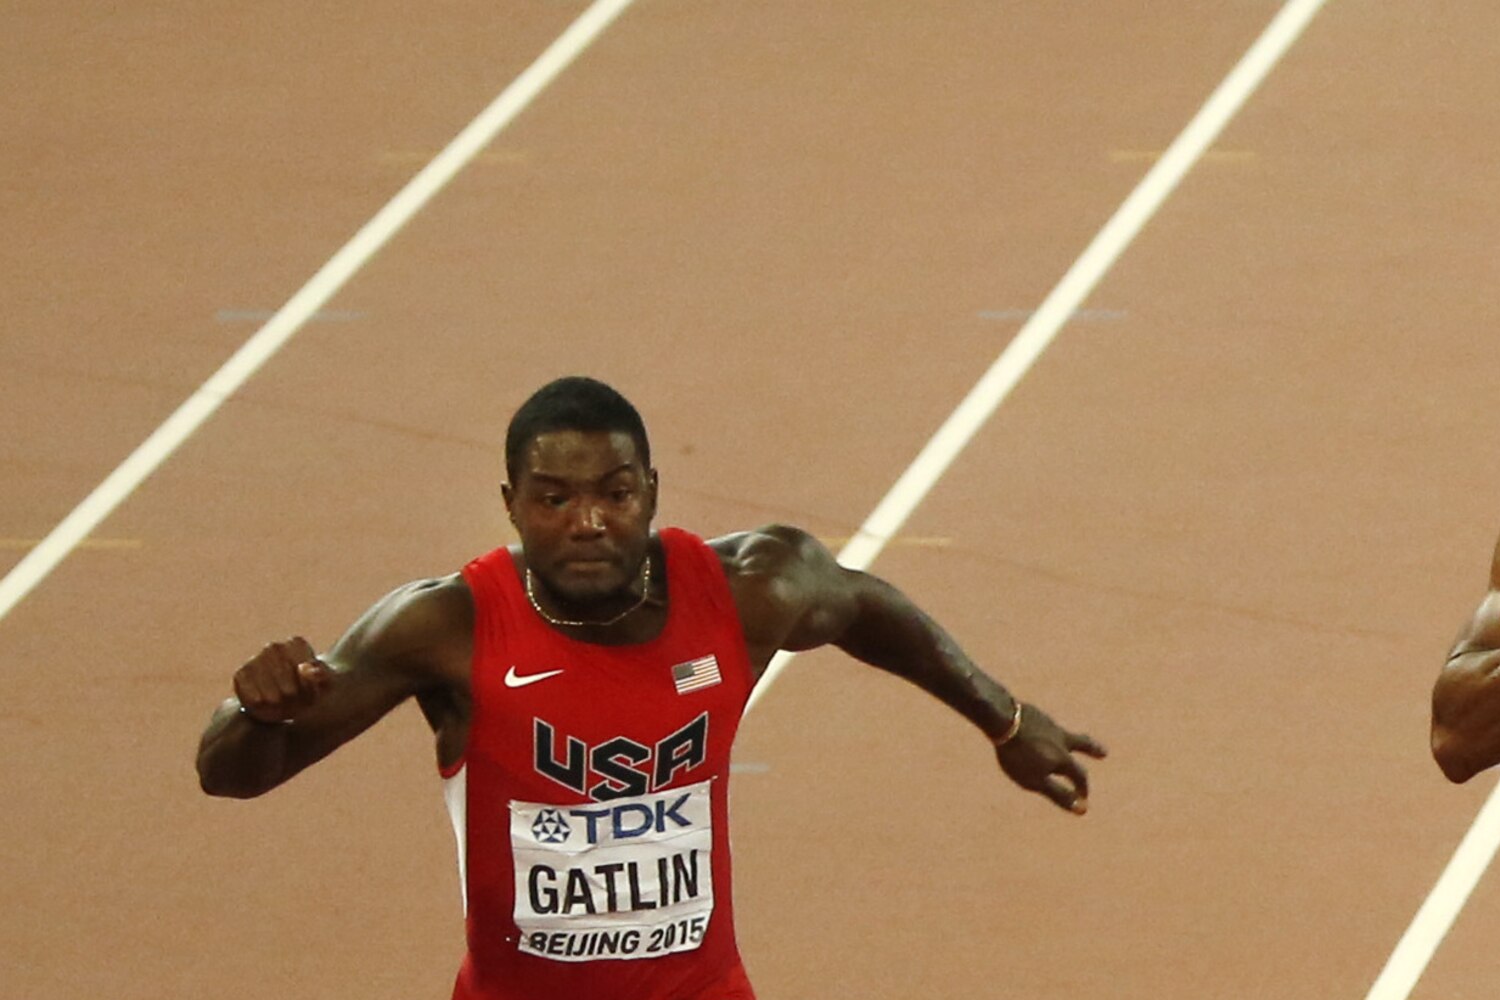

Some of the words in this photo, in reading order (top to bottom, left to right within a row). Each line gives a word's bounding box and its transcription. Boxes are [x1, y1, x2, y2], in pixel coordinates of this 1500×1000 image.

[533, 711, 709, 802] USA
[569, 792, 693, 844] TDK
[527, 849, 699, 915] GATLIN
[529, 930, 641, 957] BEIJING
[646, 917, 705, 953] 2015
